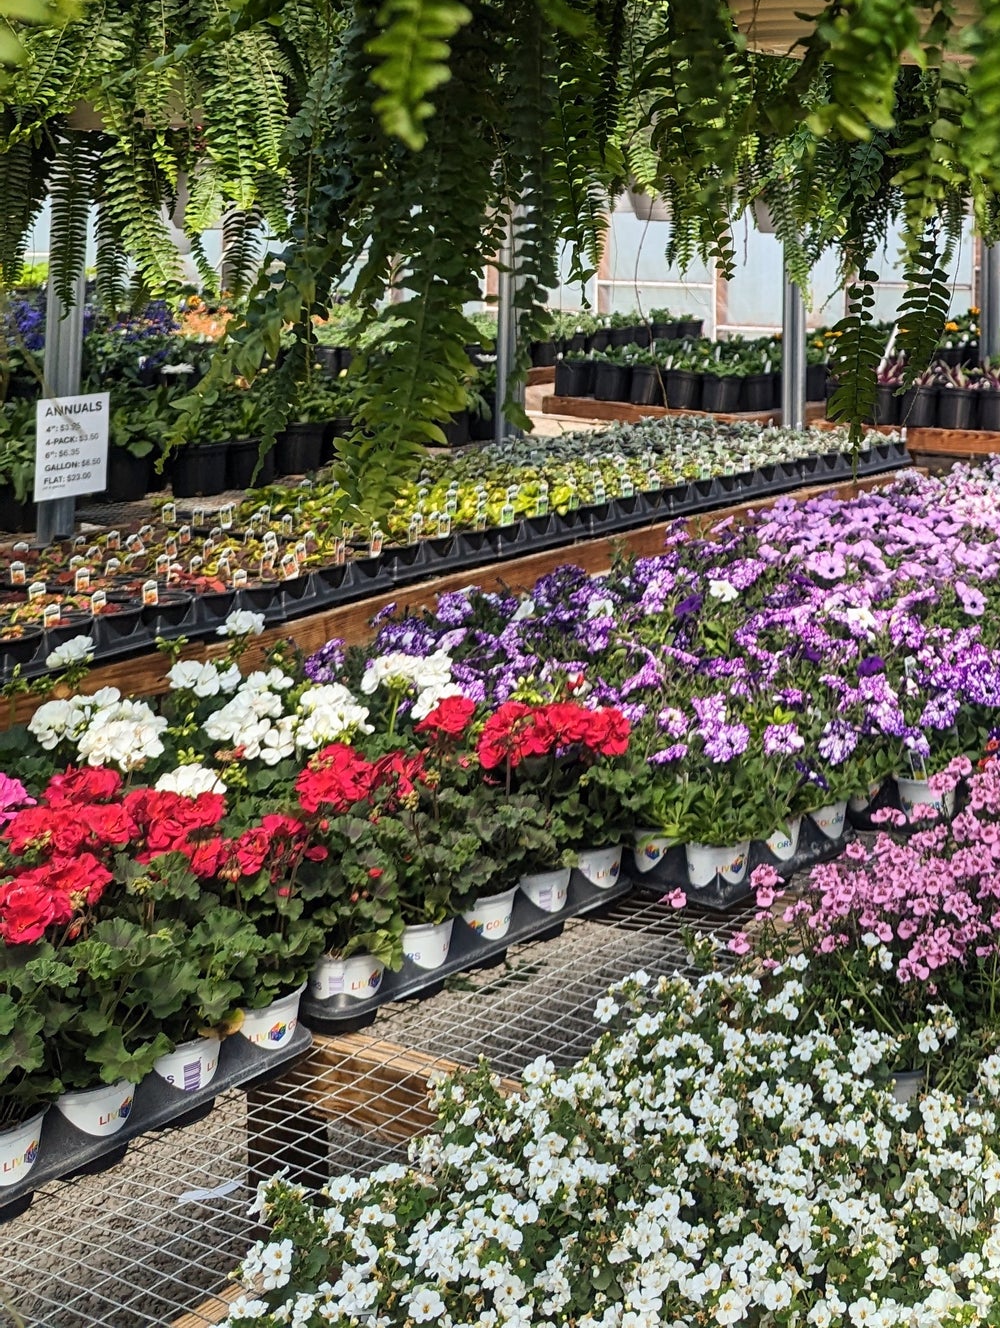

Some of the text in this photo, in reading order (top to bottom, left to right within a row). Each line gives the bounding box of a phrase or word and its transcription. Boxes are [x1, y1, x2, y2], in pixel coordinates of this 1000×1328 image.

[45, 401, 103, 417] ANNUALS
[44, 461, 80, 472] GALLON:
[43, 475, 65, 485] FLAT:
